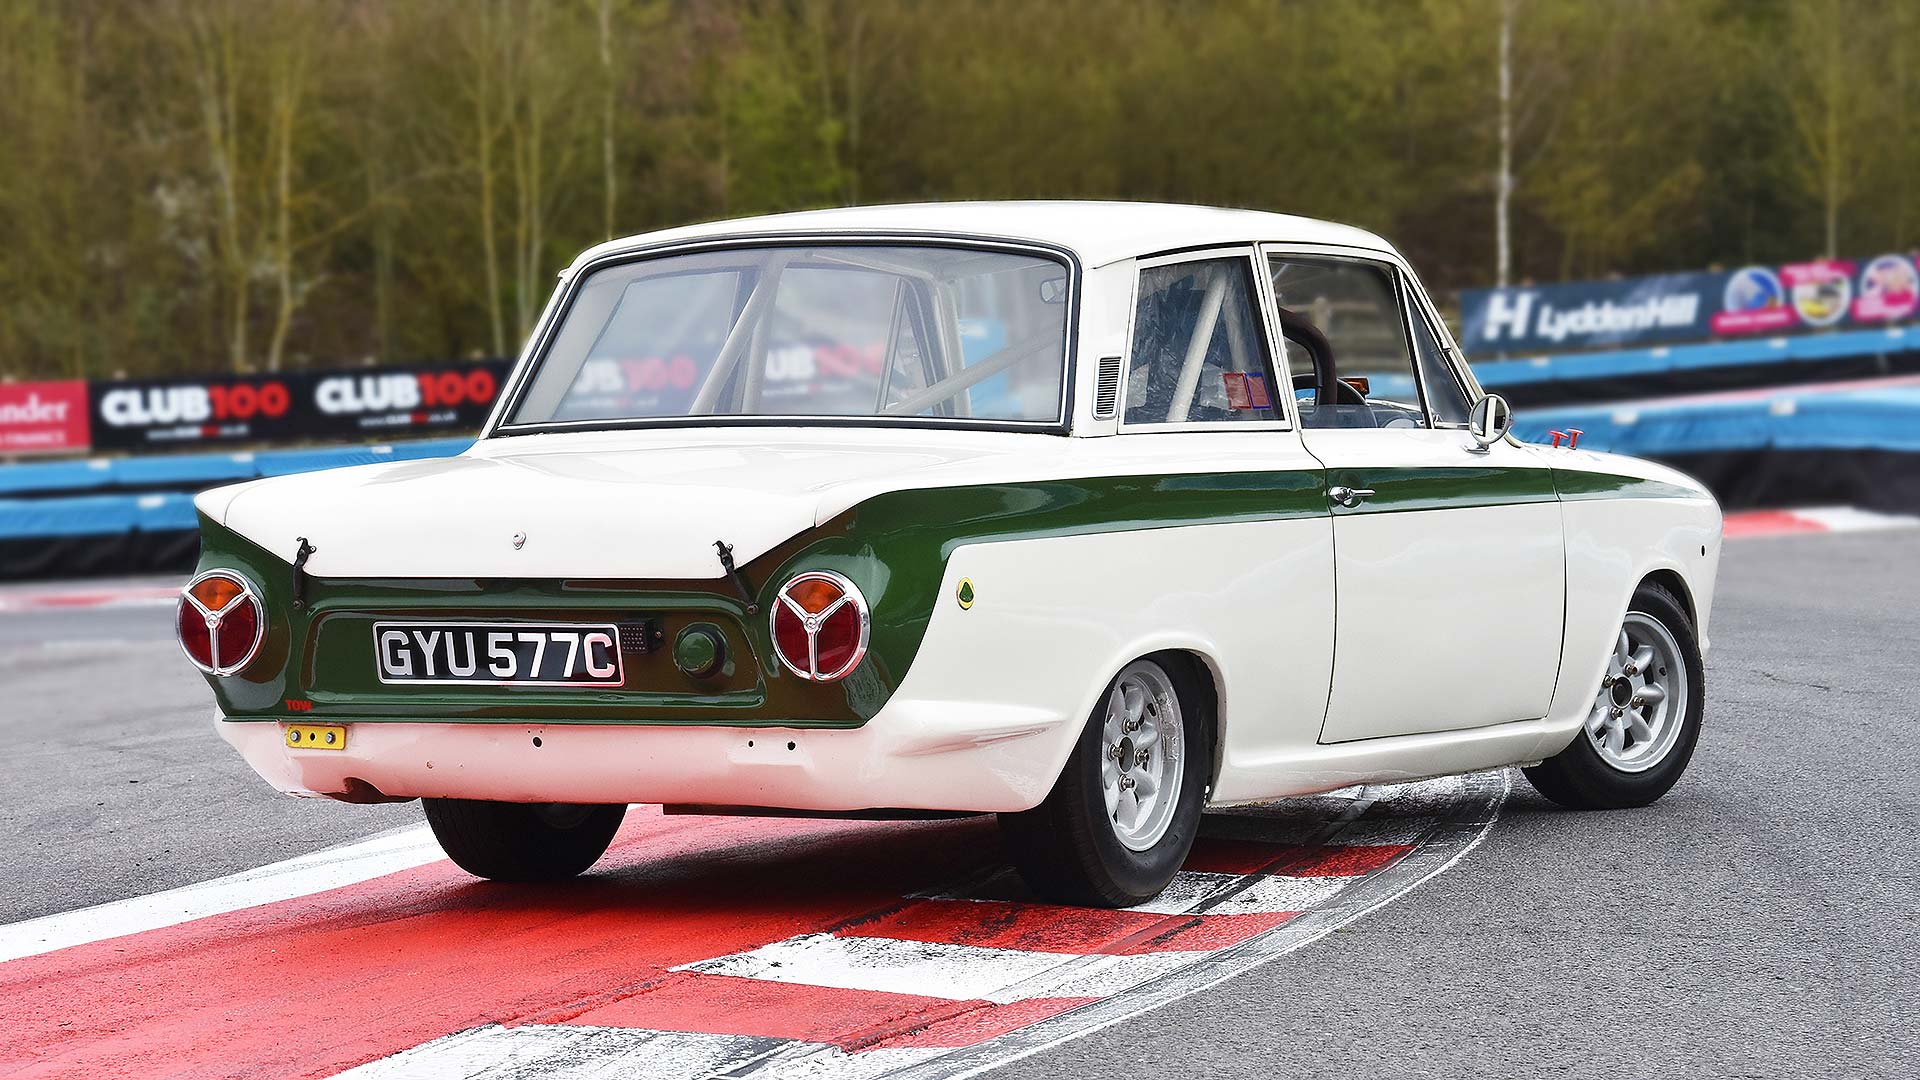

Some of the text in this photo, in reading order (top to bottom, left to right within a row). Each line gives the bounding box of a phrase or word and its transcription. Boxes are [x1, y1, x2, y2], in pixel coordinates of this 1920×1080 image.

[0, 392, 68, 423] nder
[101, 381, 290, 426] CLUB100
[315, 368, 496, 414] CLUB100
[381, 630, 616, 678] GYU 577C
[285, 699, 313, 712] TOW
